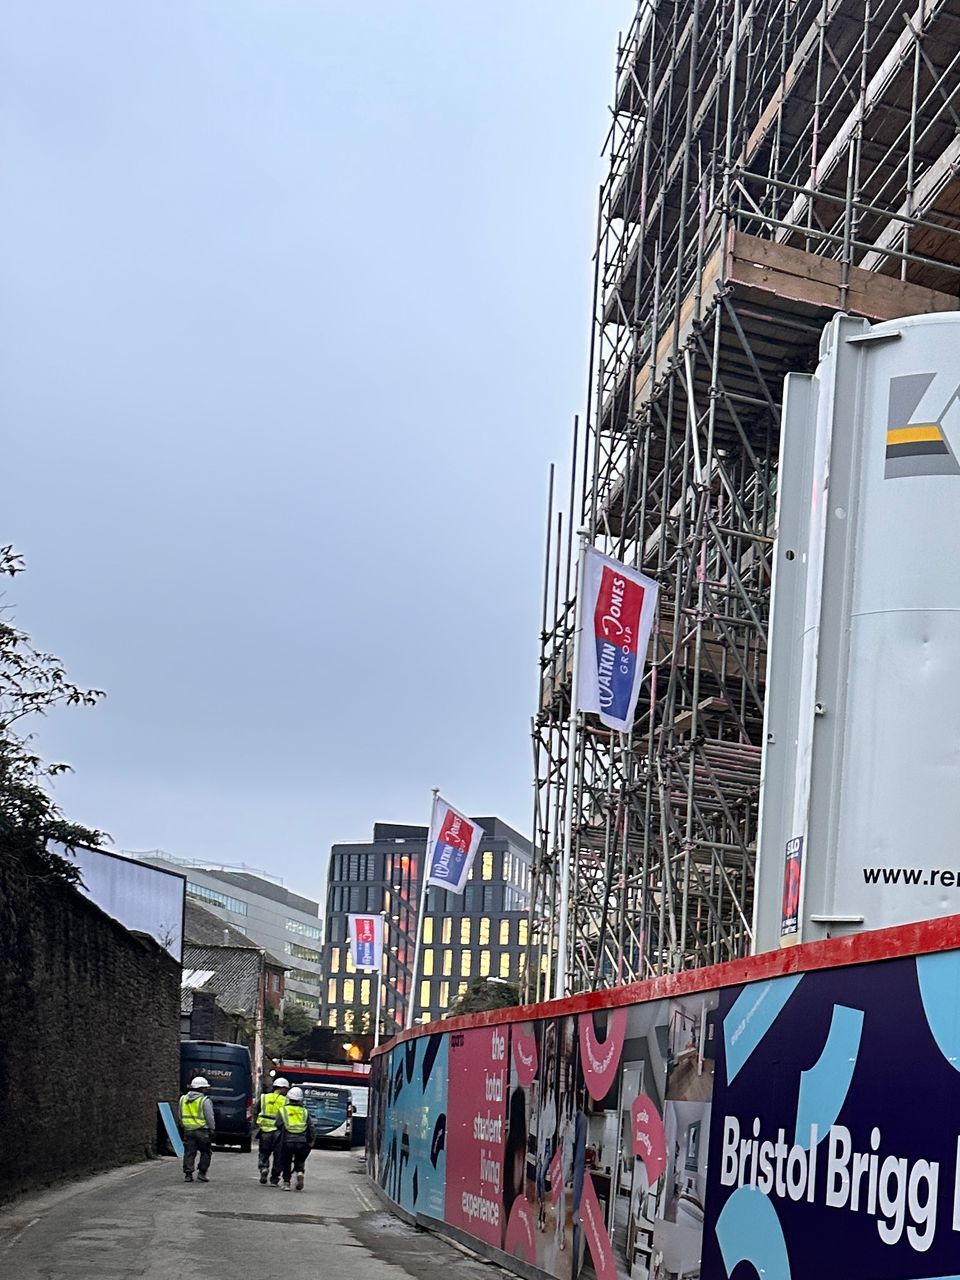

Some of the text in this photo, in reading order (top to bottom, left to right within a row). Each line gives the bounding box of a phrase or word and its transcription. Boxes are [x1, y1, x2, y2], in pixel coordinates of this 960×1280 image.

[598, 577, 626, 707] WATKIN JONES
[620, 628, 632, 674] GROUP
[492, 1027, 504, 1060] the
[485, 1069, 504, 1101] total
[473, 1109, 502, 1144] student
[480, 1148, 500, 1194] living
[720, 1115, 818, 1203] Bristol
[826, 1124, 939, 1252] Brigg
[462, 1187, 499, 1226] experience
